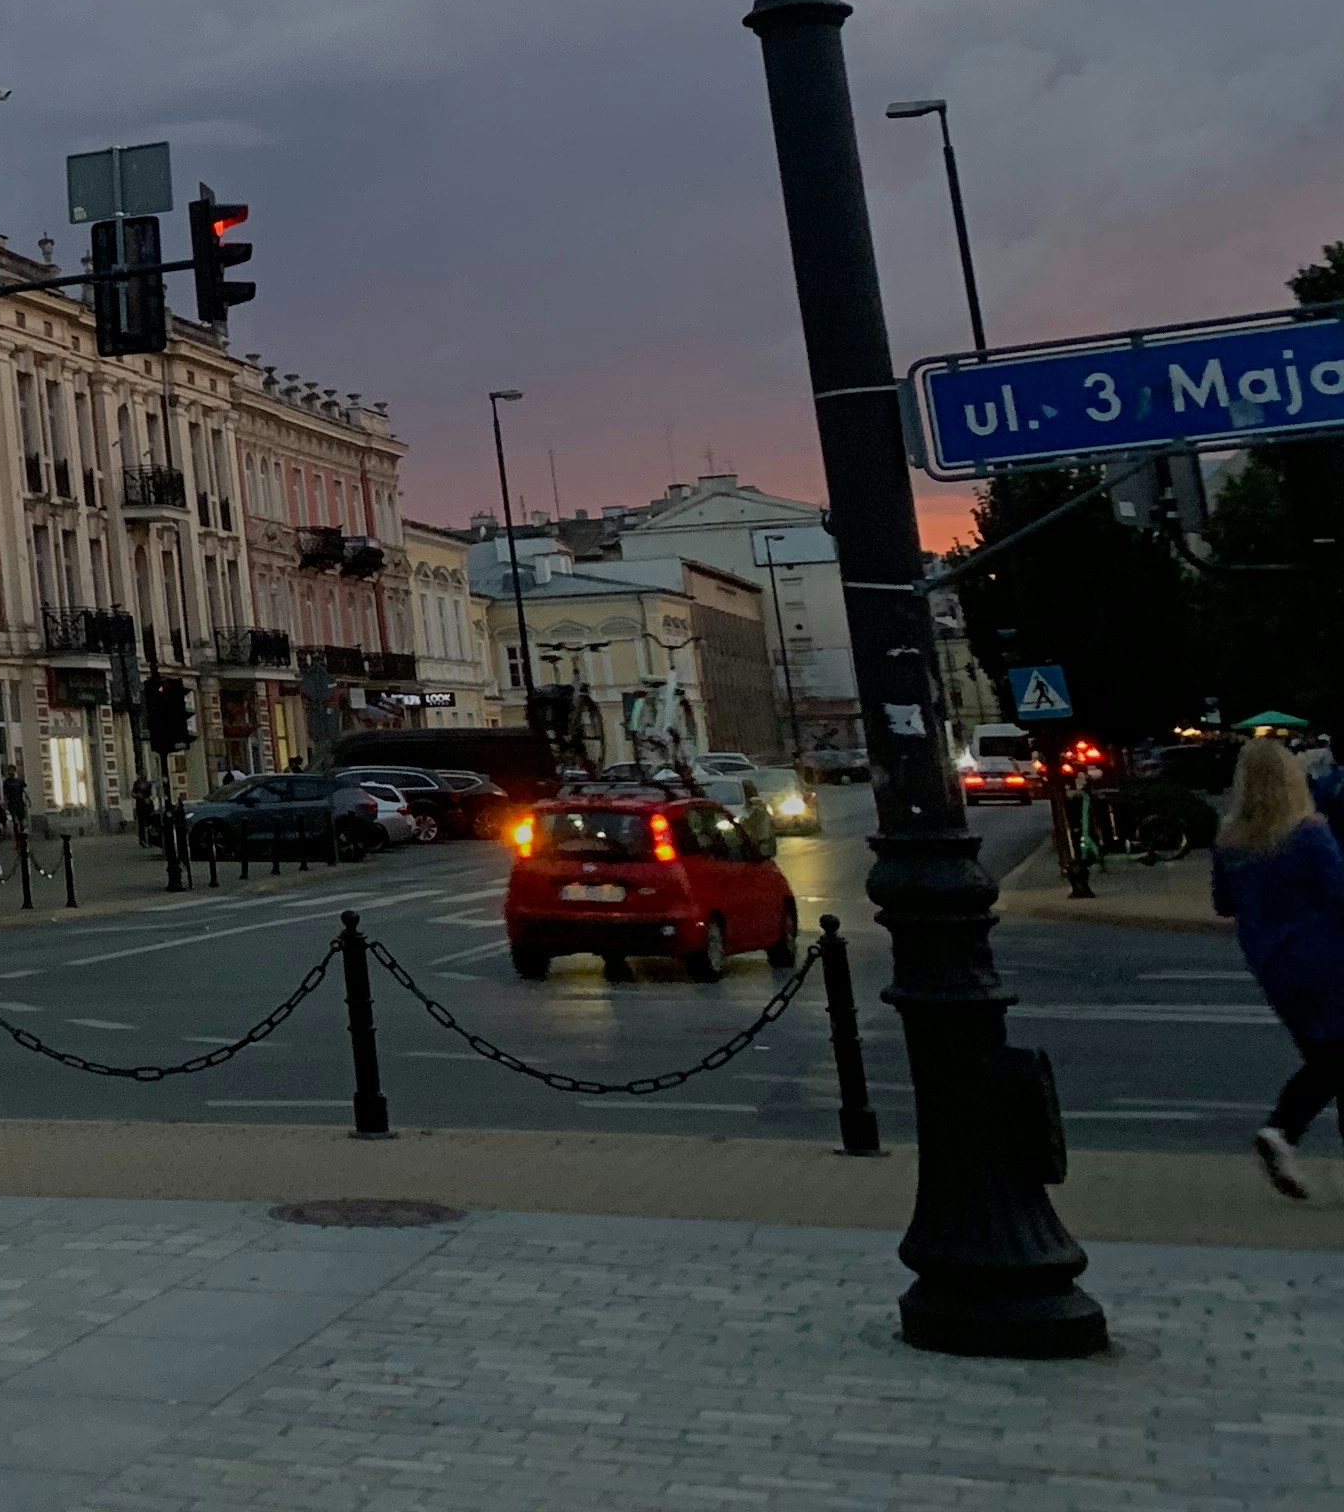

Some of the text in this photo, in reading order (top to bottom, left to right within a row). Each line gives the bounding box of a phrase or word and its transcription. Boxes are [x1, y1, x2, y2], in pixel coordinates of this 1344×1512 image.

[964, 384, 1040, 436] ul.
[1083, 372, 1122, 422] 3
[425, 693, 451, 702] LOOK
